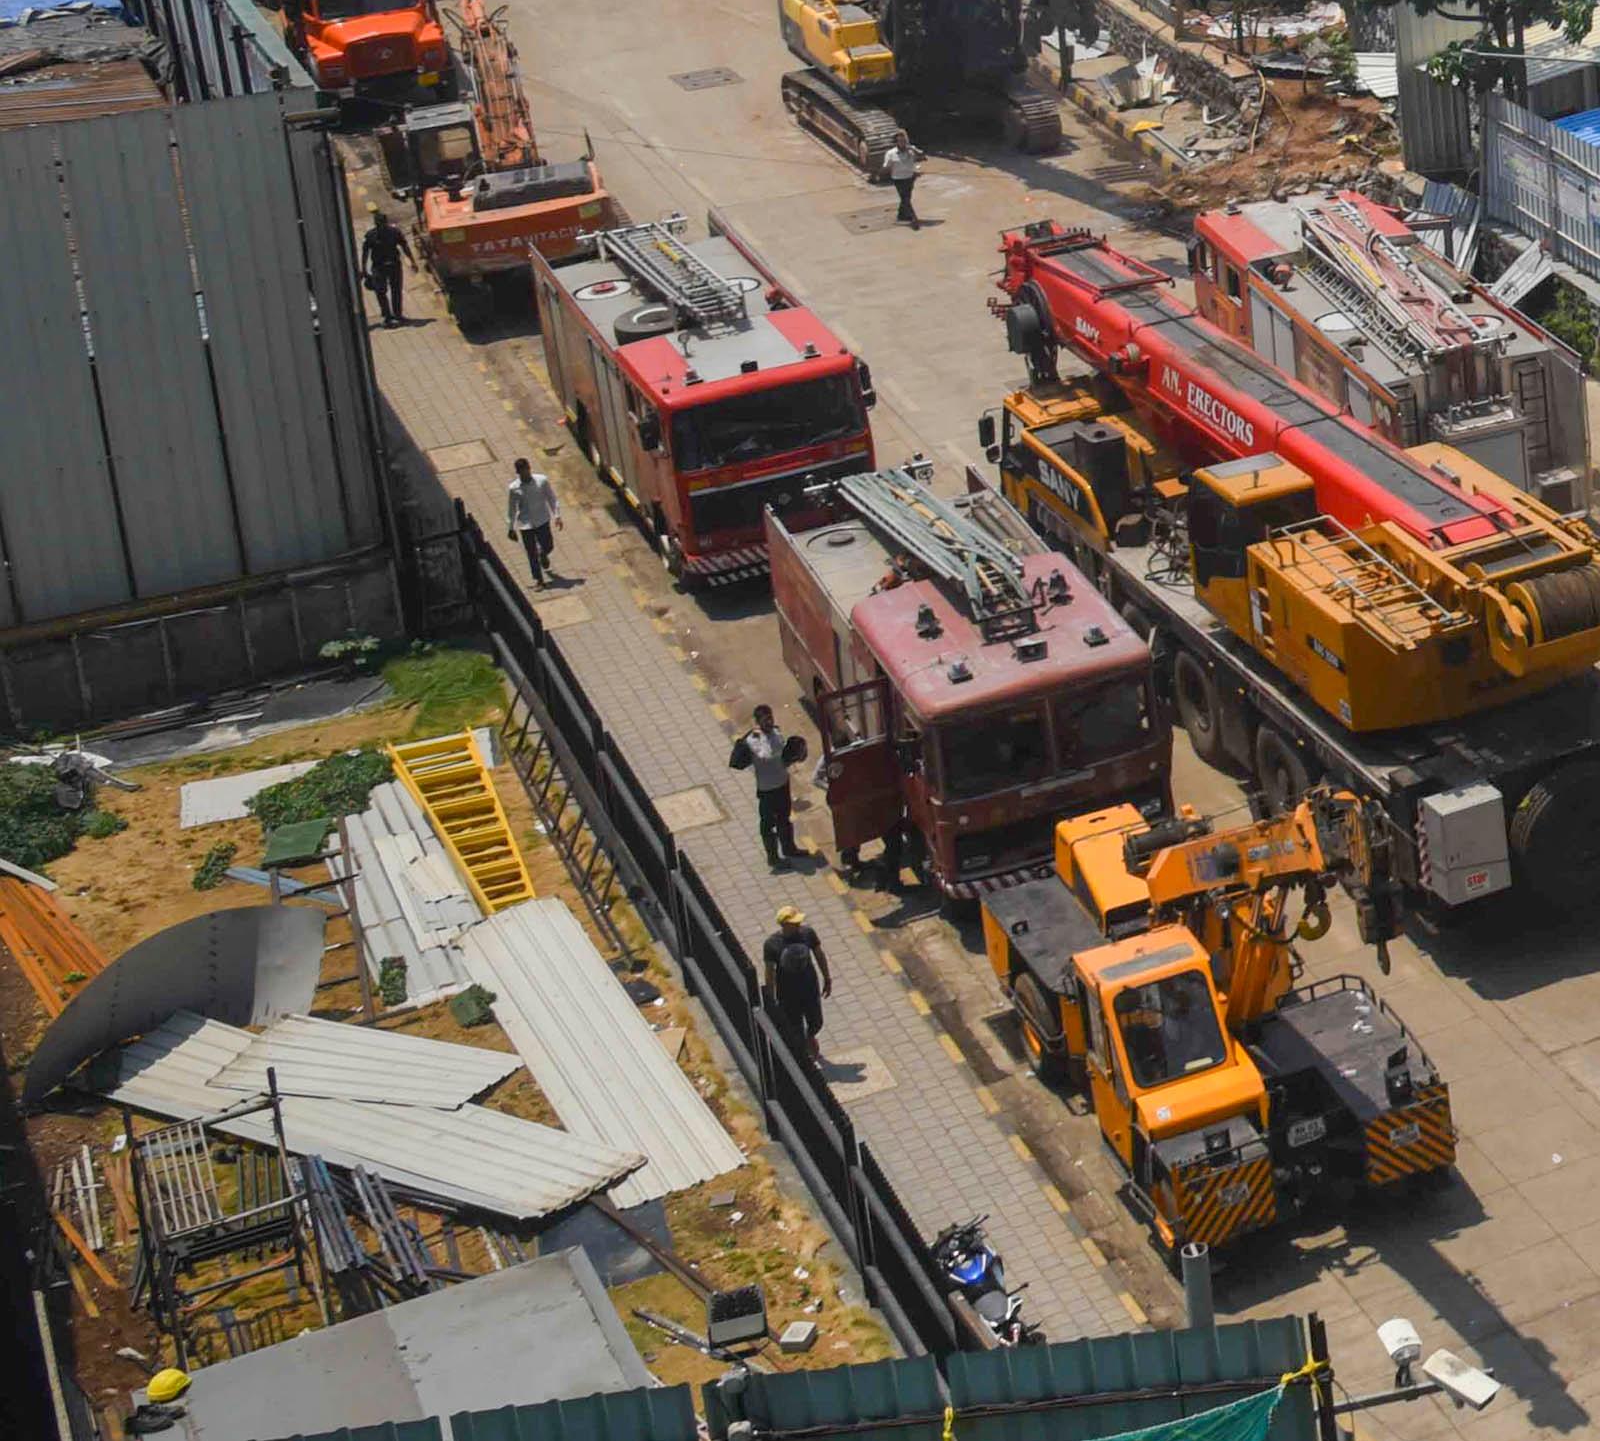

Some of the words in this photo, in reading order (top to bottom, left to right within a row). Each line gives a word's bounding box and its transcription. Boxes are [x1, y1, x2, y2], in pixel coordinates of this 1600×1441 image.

[470, 236, 523, 253] TATA
[1075, 316, 1100, 344] SANY
[1162, 366, 1183, 397] AN.
[1187, 381, 1254, 447] ERECTORS
[1038, 459, 1080, 511] SANY
